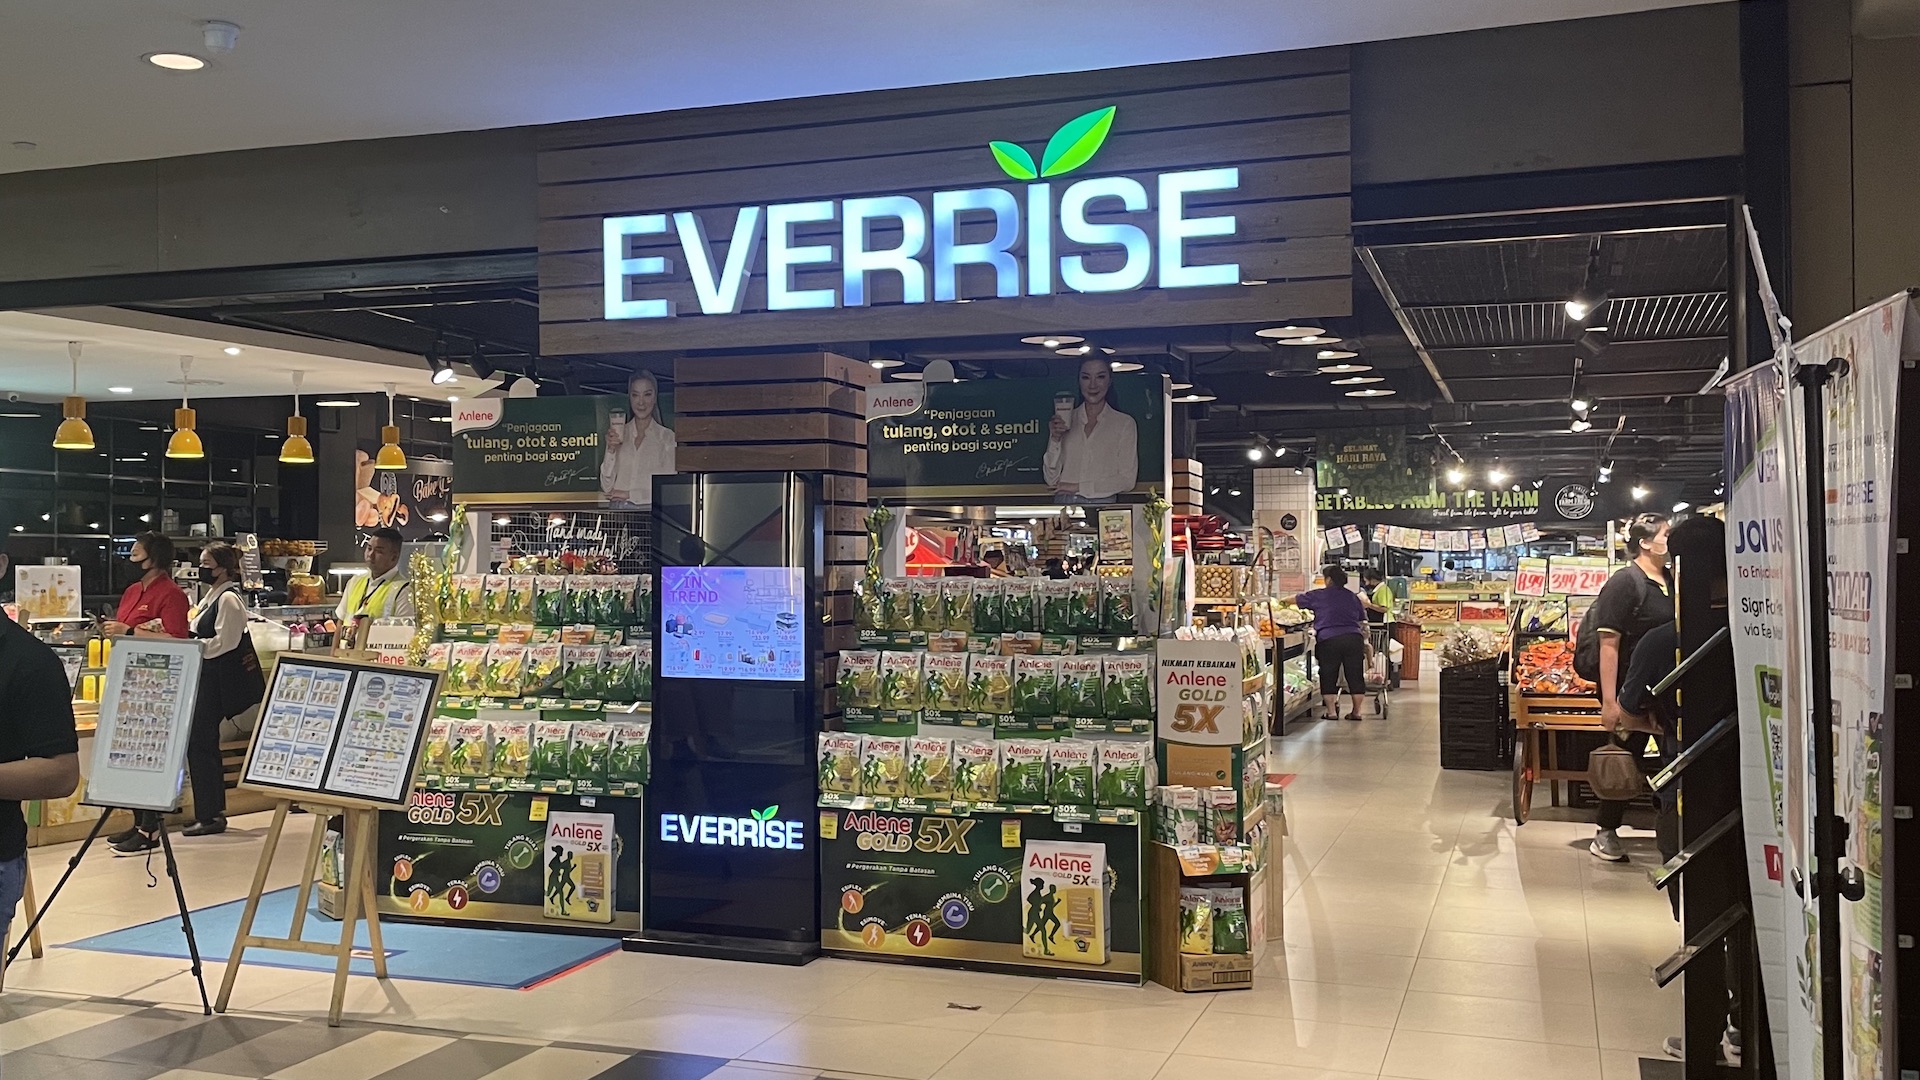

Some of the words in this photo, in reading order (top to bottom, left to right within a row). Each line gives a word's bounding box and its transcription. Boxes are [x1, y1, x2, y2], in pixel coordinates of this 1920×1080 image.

[603, 167, 1241, 320] EVERRISE
[873, 396, 914, 408] Anlene
[458, 410, 494, 422] Anlene
[882, 424, 938, 440] tulang,
[941, 424, 978, 437] otot
[980, 424, 991, 436] &
[994, 419, 1040, 435] sendi
[466, 435, 514, 451] tulang,
[516, 435, 546, 447] otot
[548, 437, 558, 447] &
[561, 433, 598, 447] sendi
[903, 441, 950, 455] penting
[951, 440, 980, 453] bagi
[484, 452, 523, 464] penting
[525, 451, 549, 463] bagi
[1362, 453, 1387, 462] RAYA
[1452, 490, 1486, 508] THE
[546, 512, 577, 543] Hand
[577, 514, 604, 542] made
[1769, 518, 1783, 553] US
[1737, 565, 1749, 578] To
[684, 575, 702, 589] IN
[669, 590, 719, 603] TREND
[1741, 596, 1765, 618] Sign
[1744, 623, 1760, 636] via
[1161, 659, 1196, 668] NIKMATI
[1196, 660, 1237, 669] KEBAIKAN
[1166, 671, 1228, 687] Anlene
[1178, 688, 1227, 702] GOLD
[846, 707, 863, 715] 50%
[1170, 703, 1226, 734] 5X
[409, 788, 456, 808] nlene
[456, 792, 509, 826] 5X
[898, 797, 916, 805] 50%
[1058, 804, 1077, 813] 50%
[408, 806, 455, 825] GOLD
[551, 823, 603, 840] Anlene
[660, 813, 805, 850] EVERRISE
[843, 810, 913, 834] Anlene
[914, 816, 978, 855] 5X
[403, 835, 434, 843] Pergerakan
[434, 836, 451, 844] Tanpa
[503, 834, 525, 851] TULANG
[586, 842, 602, 852] 5X
[856, 832, 913, 852] GOLD
[851, 863, 888, 871] Pergerakan
[888, 865, 909, 873] Tanpa
[909, 866, 936, 875] Batasan
[1029, 852, 1092, 873] Anlene
[972, 864, 998, 883] TULANG
[997, 866, 1015, 884] KUAT
[1052, 871, 1072, 879] GOLD
[1072, 874, 1092, 886] 5X
[962, 894, 975, 912] TISU
[905, 913, 931, 924] TENAGA
